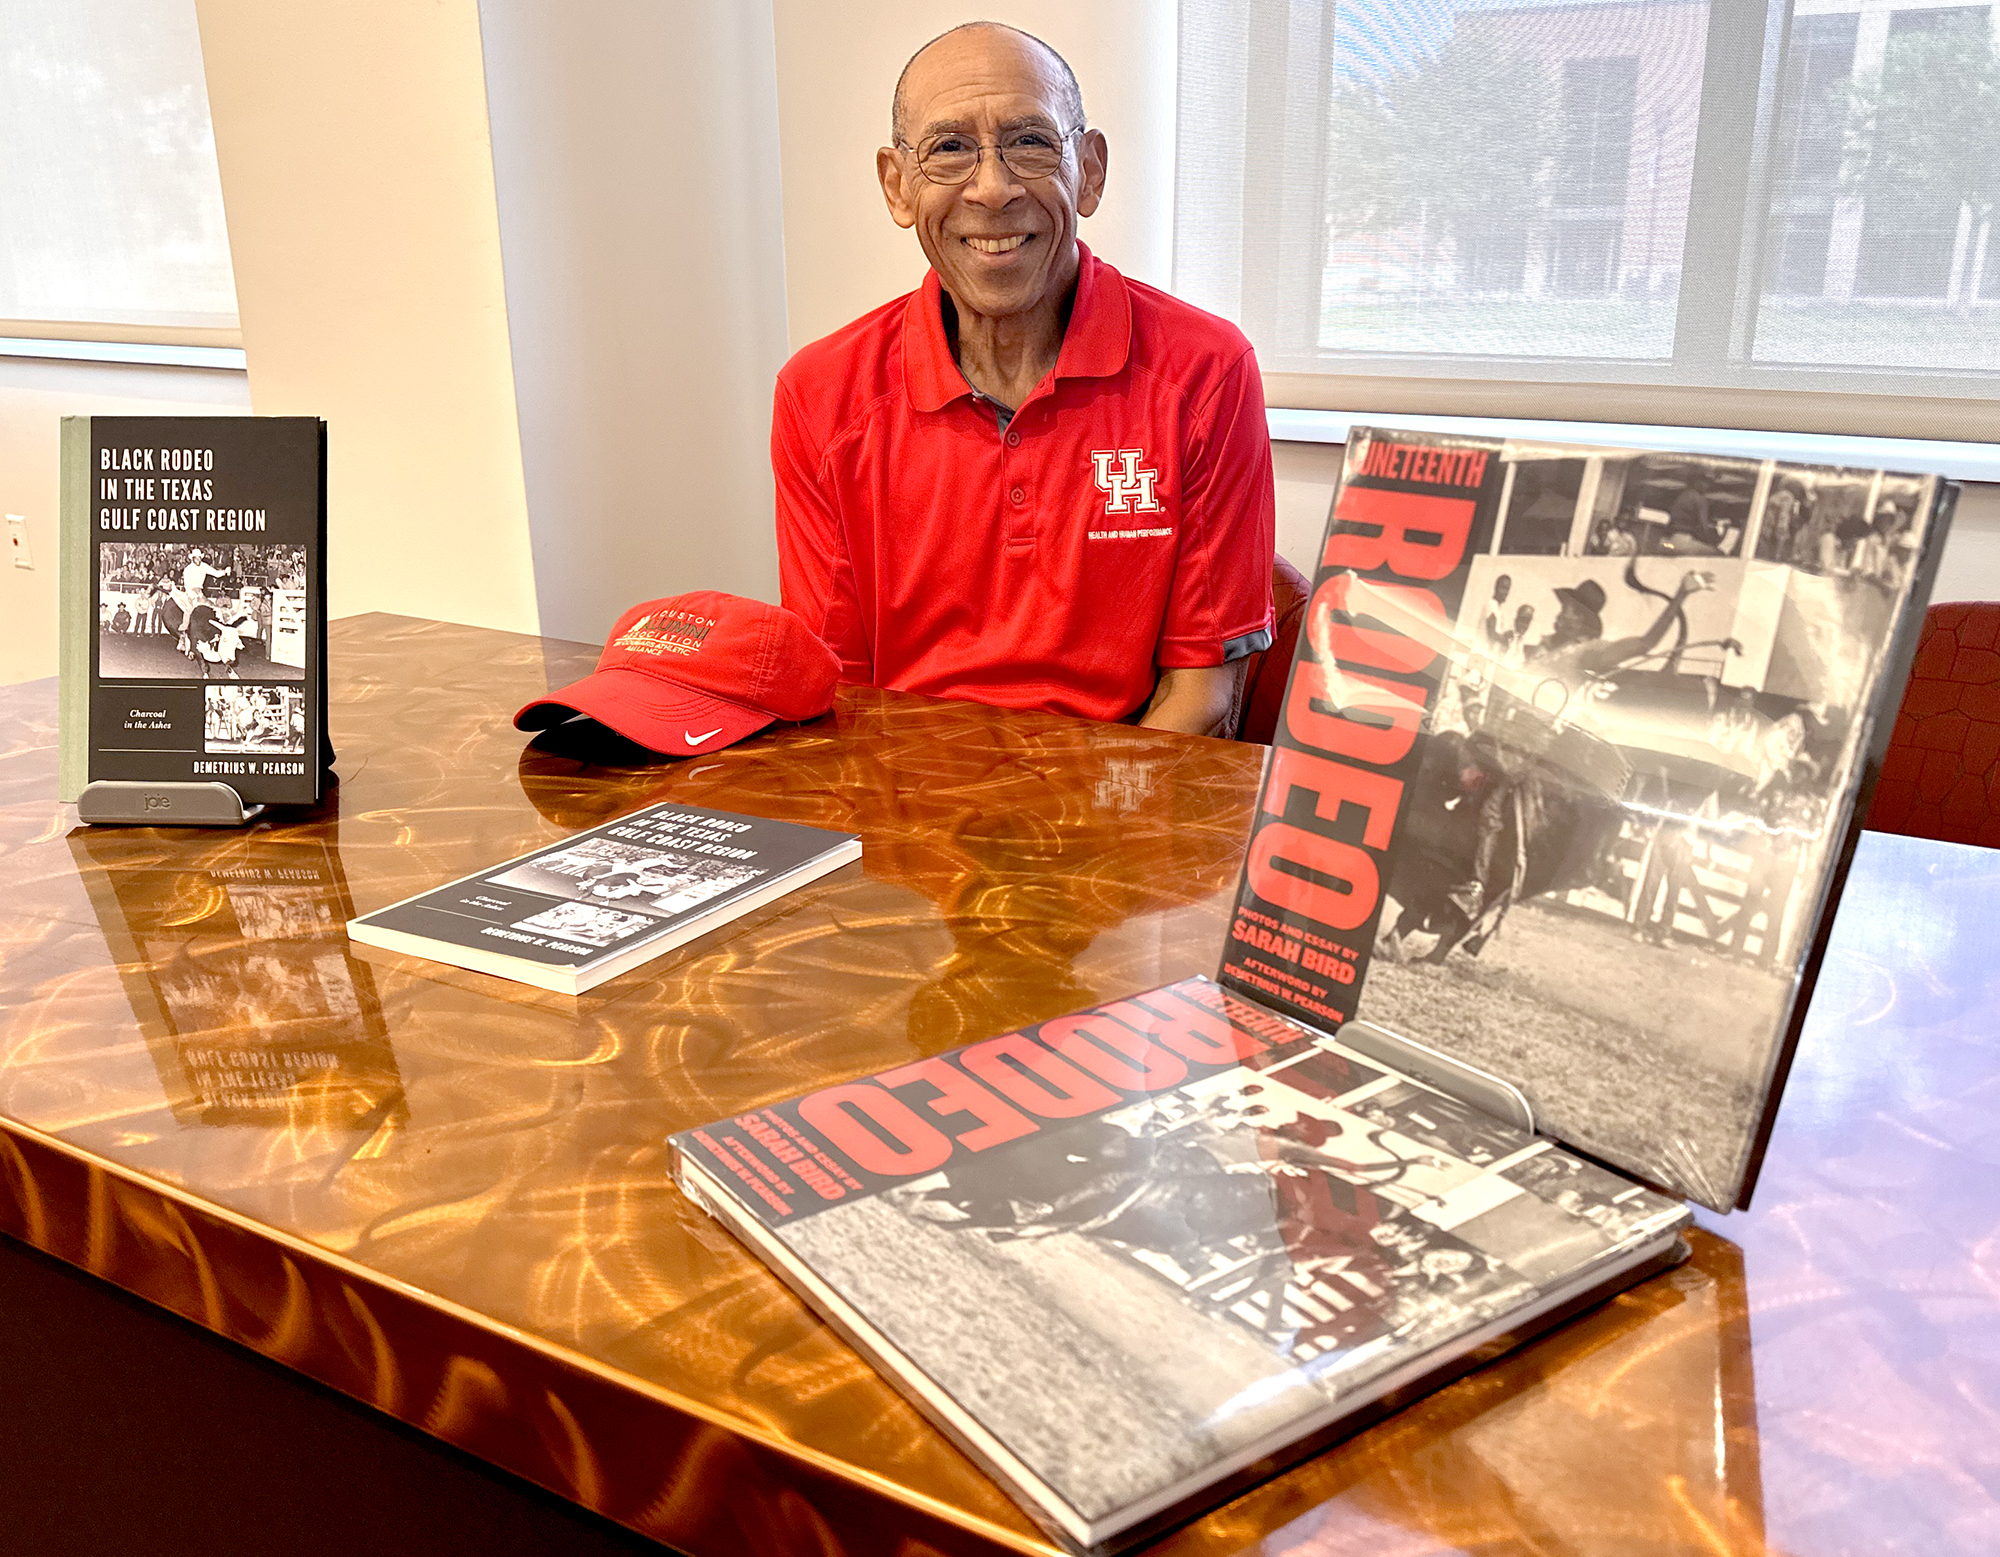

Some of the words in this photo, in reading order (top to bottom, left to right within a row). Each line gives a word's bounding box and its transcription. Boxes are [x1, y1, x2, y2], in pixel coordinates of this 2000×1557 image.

[100, 448, 154, 471] BLACK
[160, 449, 214, 471] RODEO
[100, 478, 118, 500] IN
[124, 478, 155, 501] THE
[160, 478, 213, 501] TEXAS
[100, 507, 141, 530] GULF
[147, 508, 200, 531] COAST
[206, 508, 266, 532] REGION
[655, 644, 691, 656] ATHLETIC
[129, 709, 167, 719] Charcoal
[1247, 486, 1477, 930] RODEO
[123, 721, 133, 729] in
[134, 721, 147, 729] the
[148, 721, 172, 730] Ashes
[193, 760, 246, 775] DEMETRIUS
[248, 761, 260, 775] W.
[262, 762, 305, 776] PEARSON
[144, 793, 171, 811] joie
[628, 818, 656, 828] IN
[650, 821, 686, 833] THE
[679, 826, 733, 843] TEXAS
[650, 810, 704, 824] BLACK
[699, 817, 753, 833] RODEO
[607, 826, 653, 840] GULF
[646, 833, 702, 851] COAST
[694, 843, 758, 861] REGION
[1238, 906, 1280, 930] PHOTOS
[1280, 923, 1304, 940] AND
[1304, 932, 1342, 954] ESSAY
[1341, 947, 1360, 962] BY
[1231, 919, 1302, 964] SARAH
[1301, 947, 1356, 985] BIRD
[1243, 957, 1311, 993] AFTERWORD
[1311, 985, 1329, 1000] BY
[1223, 962, 1281, 996] DEMETRIUS
[1293, 993, 1345, 1024] PEARSON
[798, 988, 1272, 1176] RODEO
[734, 1114, 805, 1165] SARAH
[788, 1158, 847, 1200] BIRD
